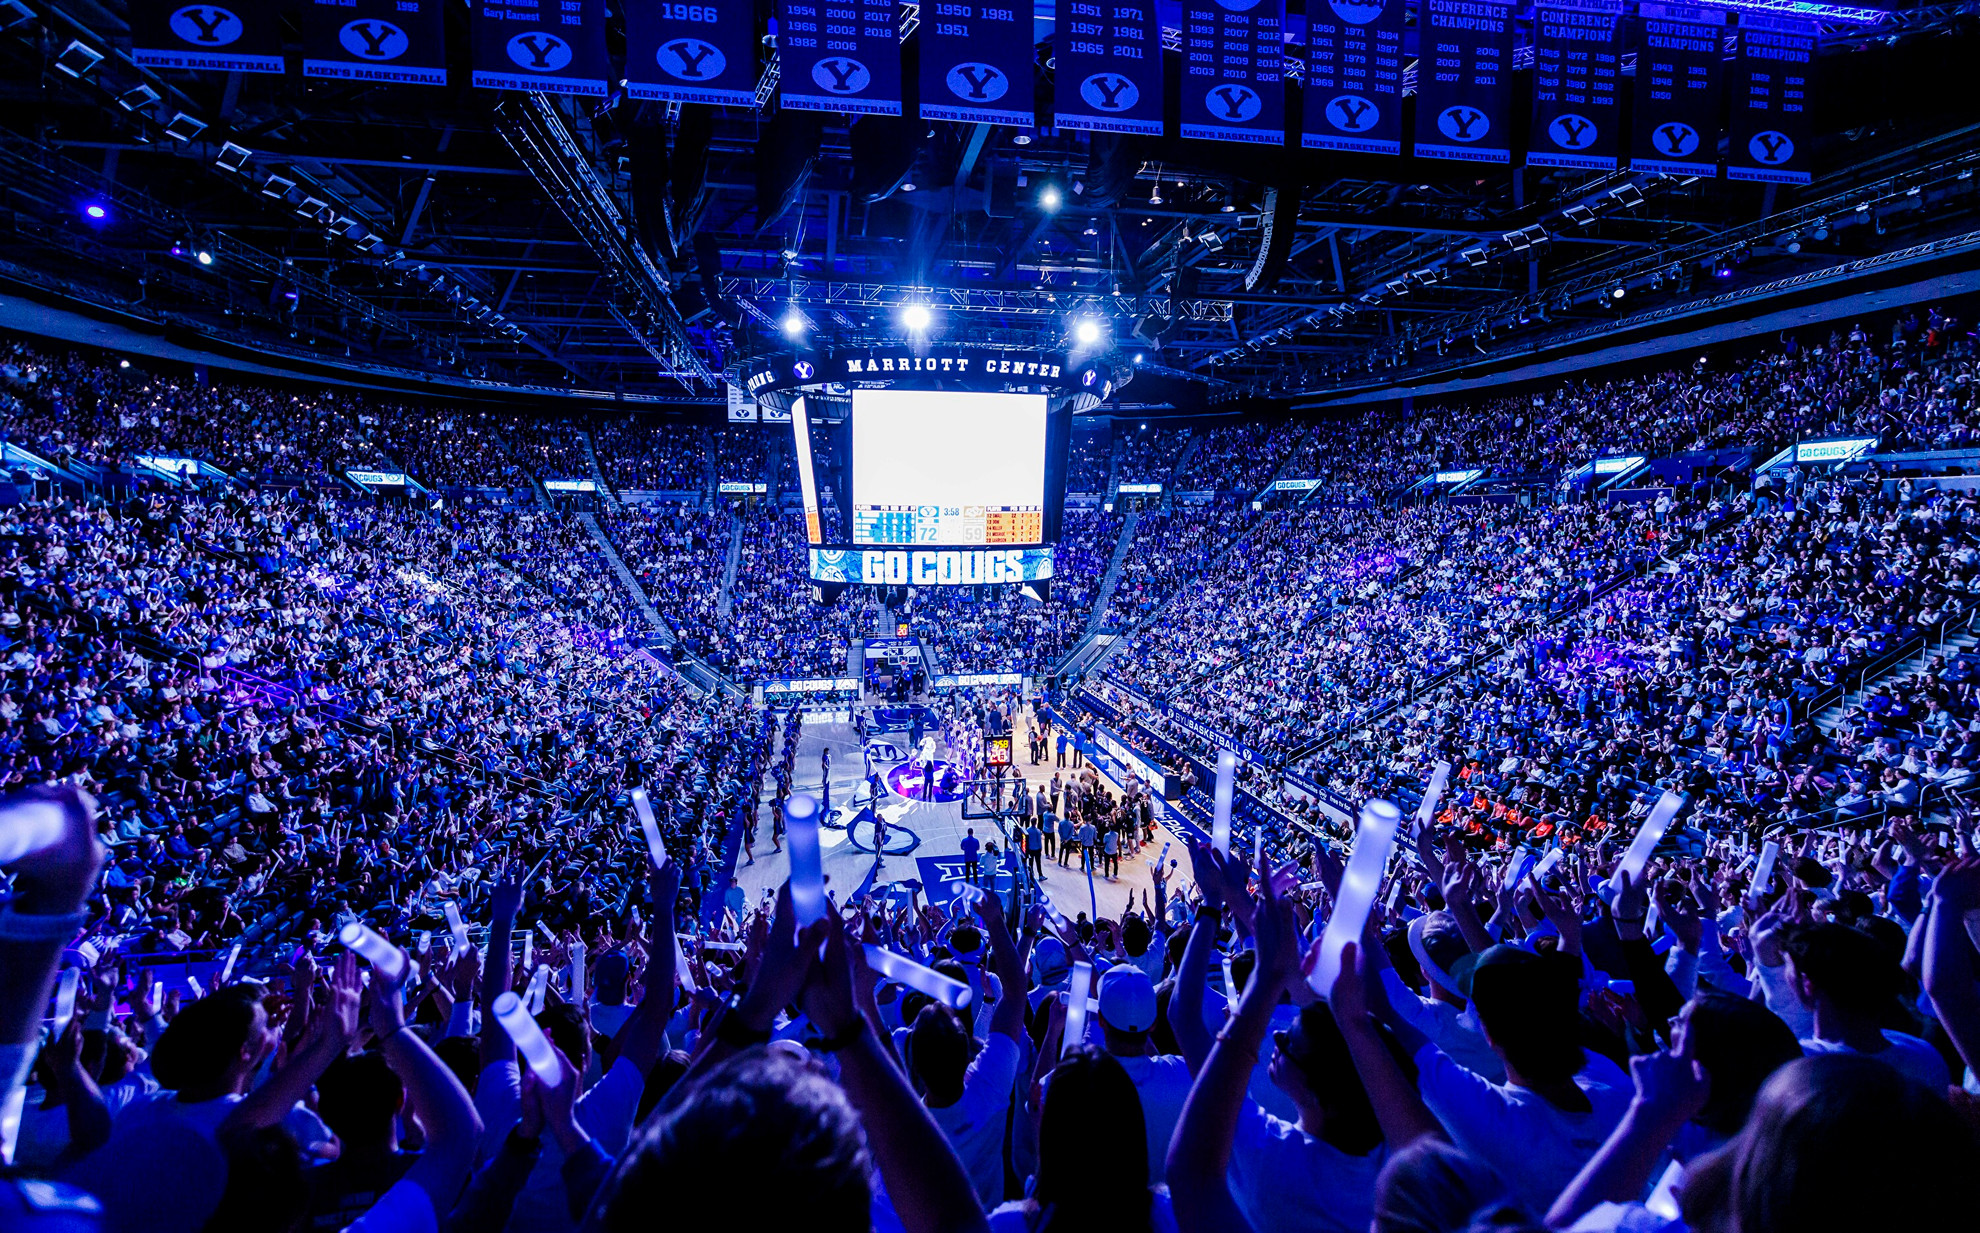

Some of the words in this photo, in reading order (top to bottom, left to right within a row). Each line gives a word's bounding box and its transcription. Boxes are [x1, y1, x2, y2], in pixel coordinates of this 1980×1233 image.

[396, 1, 419, 12] 1992
[560, 1, 581, 11] 1957
[662, 3, 718, 23] 1966
[788, 5, 816, 16] 1954
[826, 9, 856, 19] 2000
[864, 11, 891, 22] 2017
[936, 3, 972, 18] 1950
[981, 7, 1015, 22] 1981
[1070, 2, 1102, 18] 1951
[1113, 7, 1144, 21] 1971
[1429, 0, 1508, 19] CONFERENCE
[483, 8, 503, 20] Gary
[506, 9, 540, 22] Earnest
[561, 14, 582, 25] 1961
[1189, 10, 1214, 20] 1992
[1224, 13, 1250, 25] 2004
[1257, 17, 1279, 27] 2011
[1431, 14, 1504, 33] CHAMPIONS
[827, 25, 856, 35] 2002
[864, 27, 892, 37] 2018
[936, 23, 970, 37] 1951
[1070, 22, 1104, 37] 1957
[1113, 26, 1145, 40] 1981
[1189, 24, 1214, 35] 1993
[1224, 27, 1250, 38] 2007
[1257, 31, 1280, 40] 2012
[1312, 23, 1336, 34] 1950
[1344, 27, 1366, 38] 1971
[1376, 30, 1399, 41] 1984
[1543, 25, 1612, 42] CHAMPIONS
[1646, 20, 1718, 39] CONFERENCE
[788, 37, 817, 48] 1982
[827, 40, 857, 51] 2006
[1224, 41, 1250, 52] 2008
[1257, 45, 1280, 54] 2014
[1312, 37, 1334, 47] 1951
[1344, 40, 1367, 51] 1972
[1437, 43, 1460, 53] 2001
[1648, 35, 1714, 52] CHAMPIONS
[1745, 31, 1814, 50] CONFERENCE
[1070, 41, 1104, 55] 1965
[1113, 45, 1144, 59] 2011
[1311, 51, 1335, 60] 1957
[1344, 54, 1366, 64] 1979
[1746, 46, 1810, 63] CHAMPIONS
[137, 56, 182, 67] MEN'S
[187, 59, 281, 71] BASKETBALL
[1189, 52, 1213, 63] 2001
[1224, 55, 1249, 66] 2009
[1257, 58, 1280, 68] 2015
[308, 67, 350, 77] MEN'S
[355, 70, 444, 83] BASKETBALL
[1189, 66, 1215, 76] 2003
[1223, 69, 1247, 79] 2010
[1256, 72, 1279, 82] 2021
[1311, 64, 1334, 75] 1965
[475, 78, 518, 88] MEN'S
[522, 81, 605, 95] BASKETBALL
[1435, 72, 1460, 82] 2007
[1475, 76, 1497, 85] 2011
[631, 89, 670, 99] MEN'S
[674, 92, 753, 105] BASKETBALL
[783, 100, 821, 110] MEN'S
[824, 102, 900, 115] BASKETBALL
[922, 110, 958, 120] MEN'S
[960, 112, 1033, 126] BASKETBALL
[1056, 120, 1090, 130] MEN'S
[1093, 122, 1162, 134] BASKETBALL
[1183, 129, 1215, 139] MEN'S
[1217, 131, 1282, 144] BASKETBALL
[1303, 138, 1335, 149] MEN'S
[1337, 141, 1399, 154] BASKETBALL
[1417, 148, 1446, 158] MEN'S
[1449, 150, 1508, 162] BASKETBALL
[1529, 157, 1557, 166] MEN'S
[1559, 158, 1615, 170] BASKETBALL
[847, 358, 968, 373] MARRIOTT
[986, 360, 1061, 378] CENTER
[1800, 448, 1812, 457] GO
[1813, 446, 1846, 456] COUGS
[1286, 481, 1306, 489] COUGS
[944, 508, 960, 516] 3:58
[920, 527, 937, 541] 72
[965, 527, 982, 541] 59
[862, 550, 907, 585] GO
[911, 550, 1023, 585] COUGS
